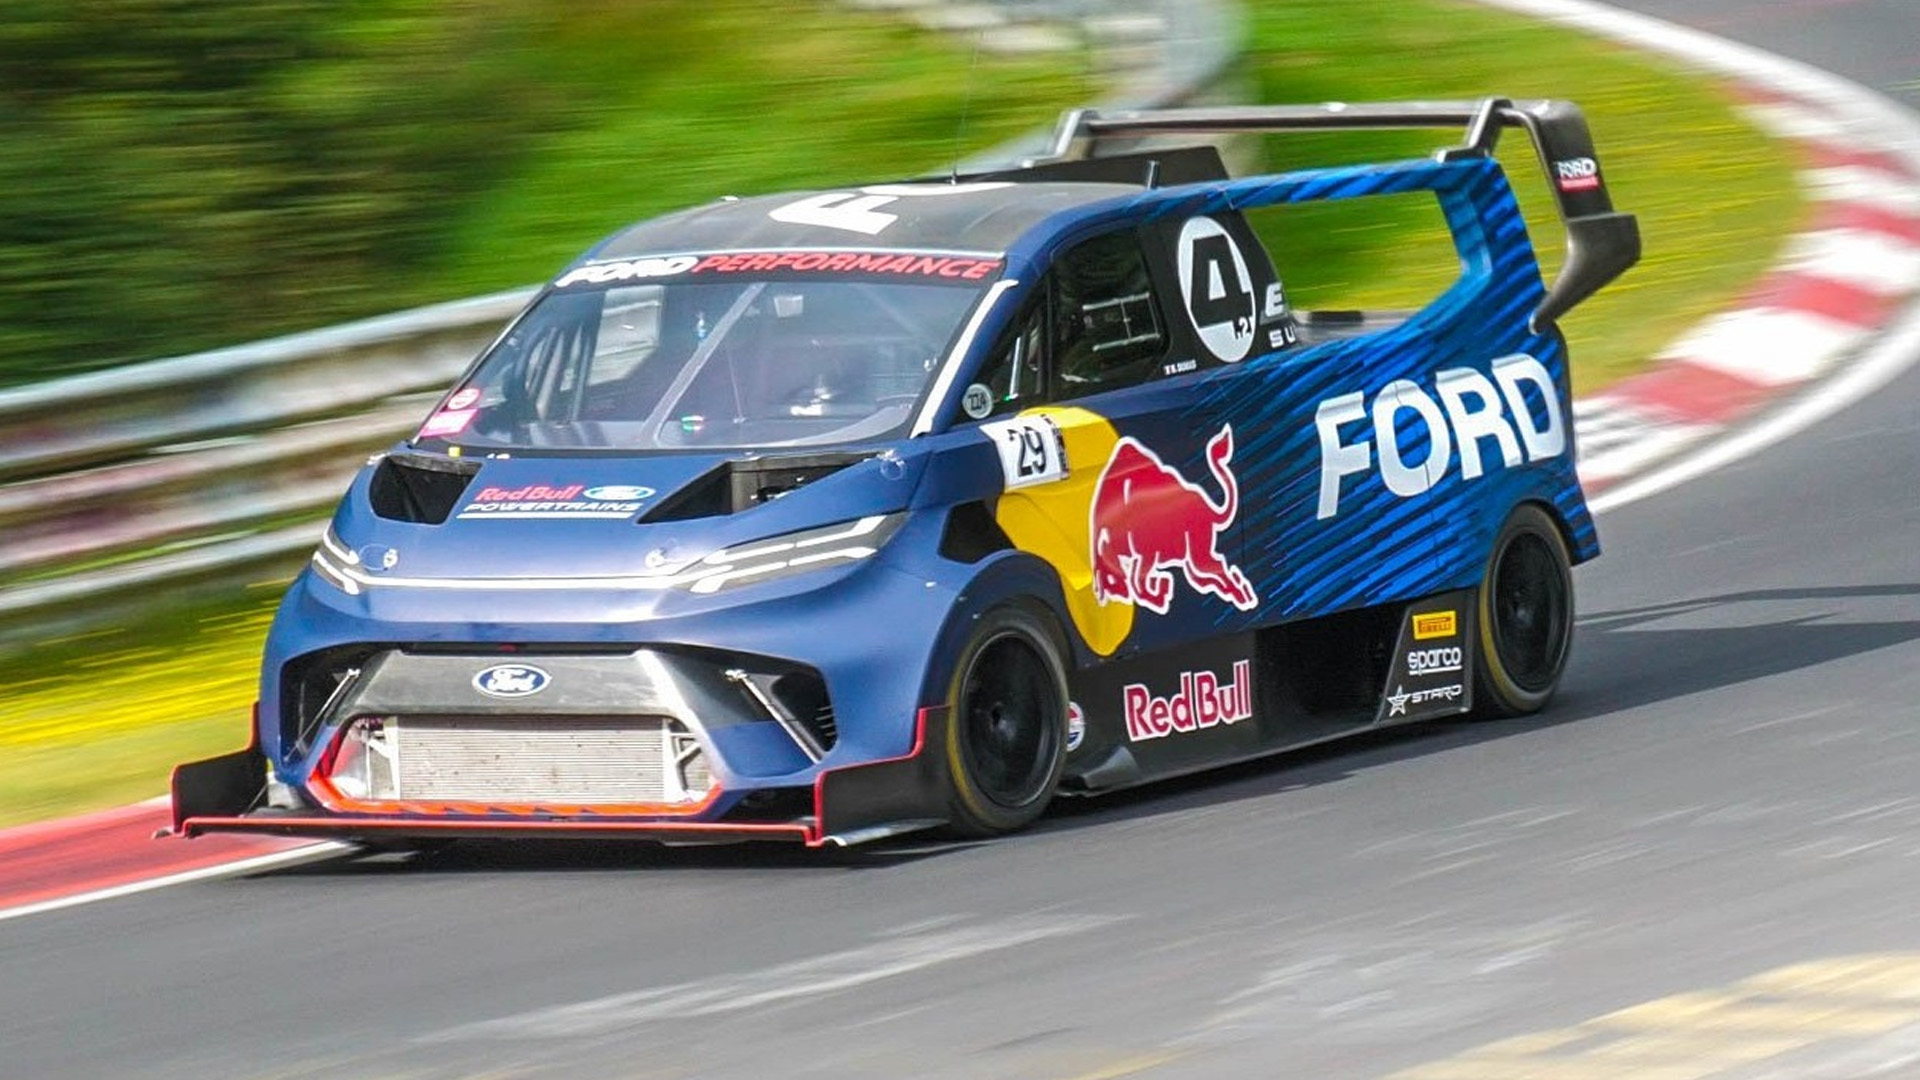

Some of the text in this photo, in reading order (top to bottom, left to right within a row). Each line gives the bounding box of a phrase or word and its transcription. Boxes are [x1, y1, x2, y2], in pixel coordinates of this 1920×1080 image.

[1555, 157, 1597, 178] FORD
[554, 253, 1002, 287] FORD PERFORMANCE
[1007, 426, 1047, 477] 29
[1315, 353, 1565, 520] FORD
[463, 502, 644, 513] POWERTRAINS
[1408, 647, 1462, 676] sparco
